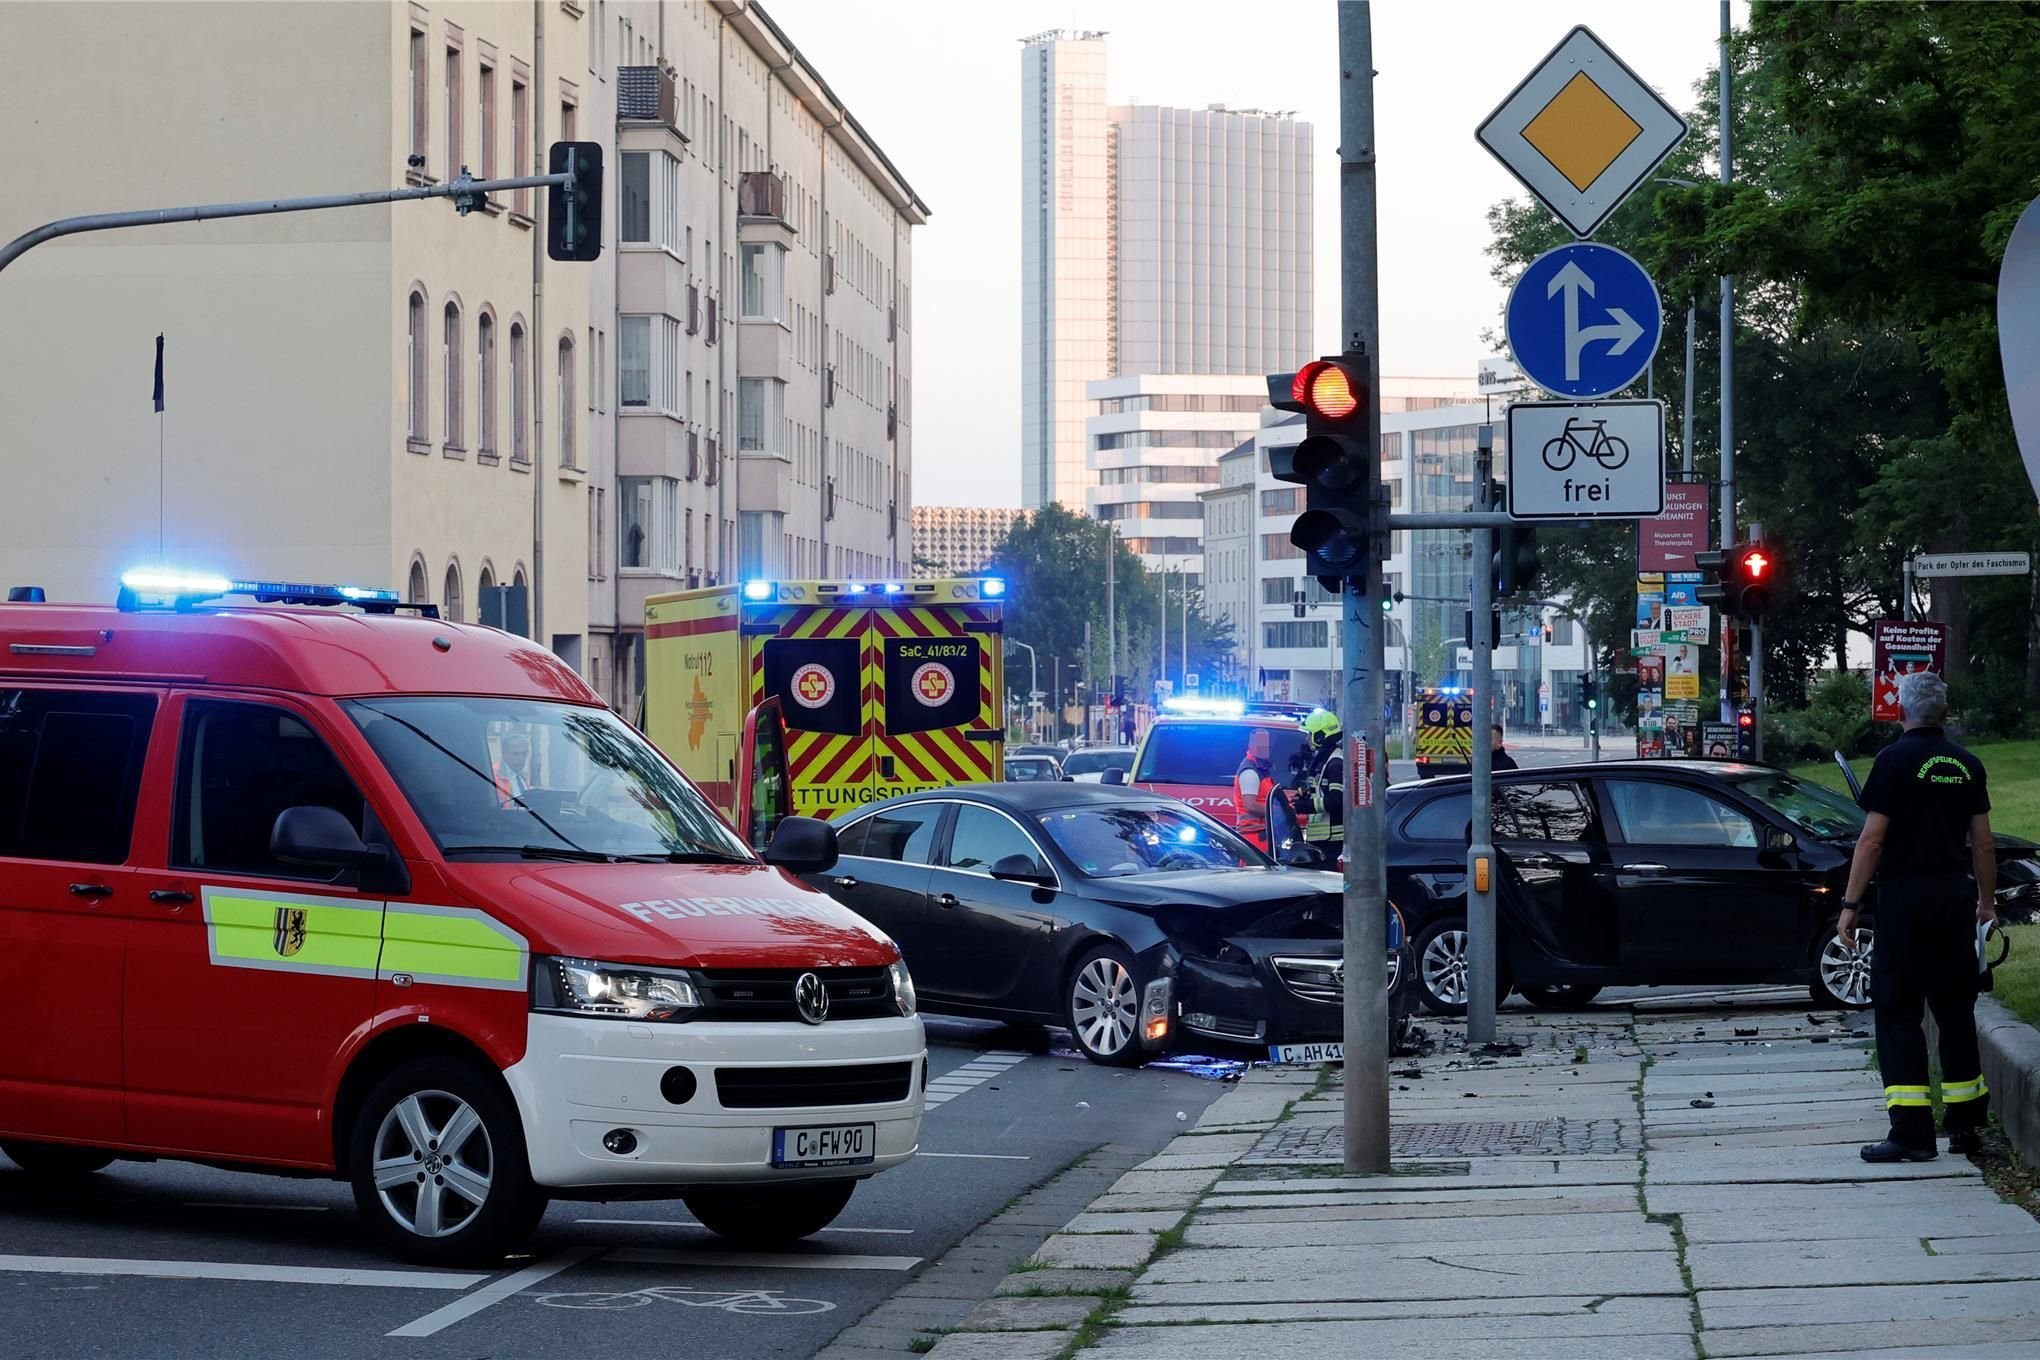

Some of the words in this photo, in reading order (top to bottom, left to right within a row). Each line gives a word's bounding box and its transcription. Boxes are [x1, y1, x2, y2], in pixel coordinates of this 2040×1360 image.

[1563, 477, 1610, 502] frei
[1656, 512, 1694, 520] HEMNITZ
[1918, 561, 1933, 570] Park
[1936, 561, 1948, 569] der
[1950, 560, 1969, 570] Opfer
[1972, 560, 1985, 568] des
[1987, 558, 2026, 568] Faschismus
[1673, 612, 1702, 620] SICHERE
[1690, 628, 1705, 636] PRO
[1883, 626, 1908, 634] Keine
[1909, 627, 1939, 635] Profite
[1880, 634, 1895, 642] auf
[1896, 635, 1926, 643] Kosten
[900, 645, 967, 659] SaC_41/83/2
[1885, 643, 1937, 651] Gesundheit!
[700, 651, 713, 677] 112
[1358, 743, 1366, 766] LETZTE
[1358, 766, 1367, 806] GENERATION
[619, 896, 843, 924] FEUERWEHR
[1283, 1047, 1295, 1062] C
[1304, 1044, 1323, 1061] AH
[1325, 1044, 1344, 1059] 41
[797, 1132, 808, 1157] C
[819, 1130, 841, 1156] FW
[844, 1128, 863, 1154] 90
